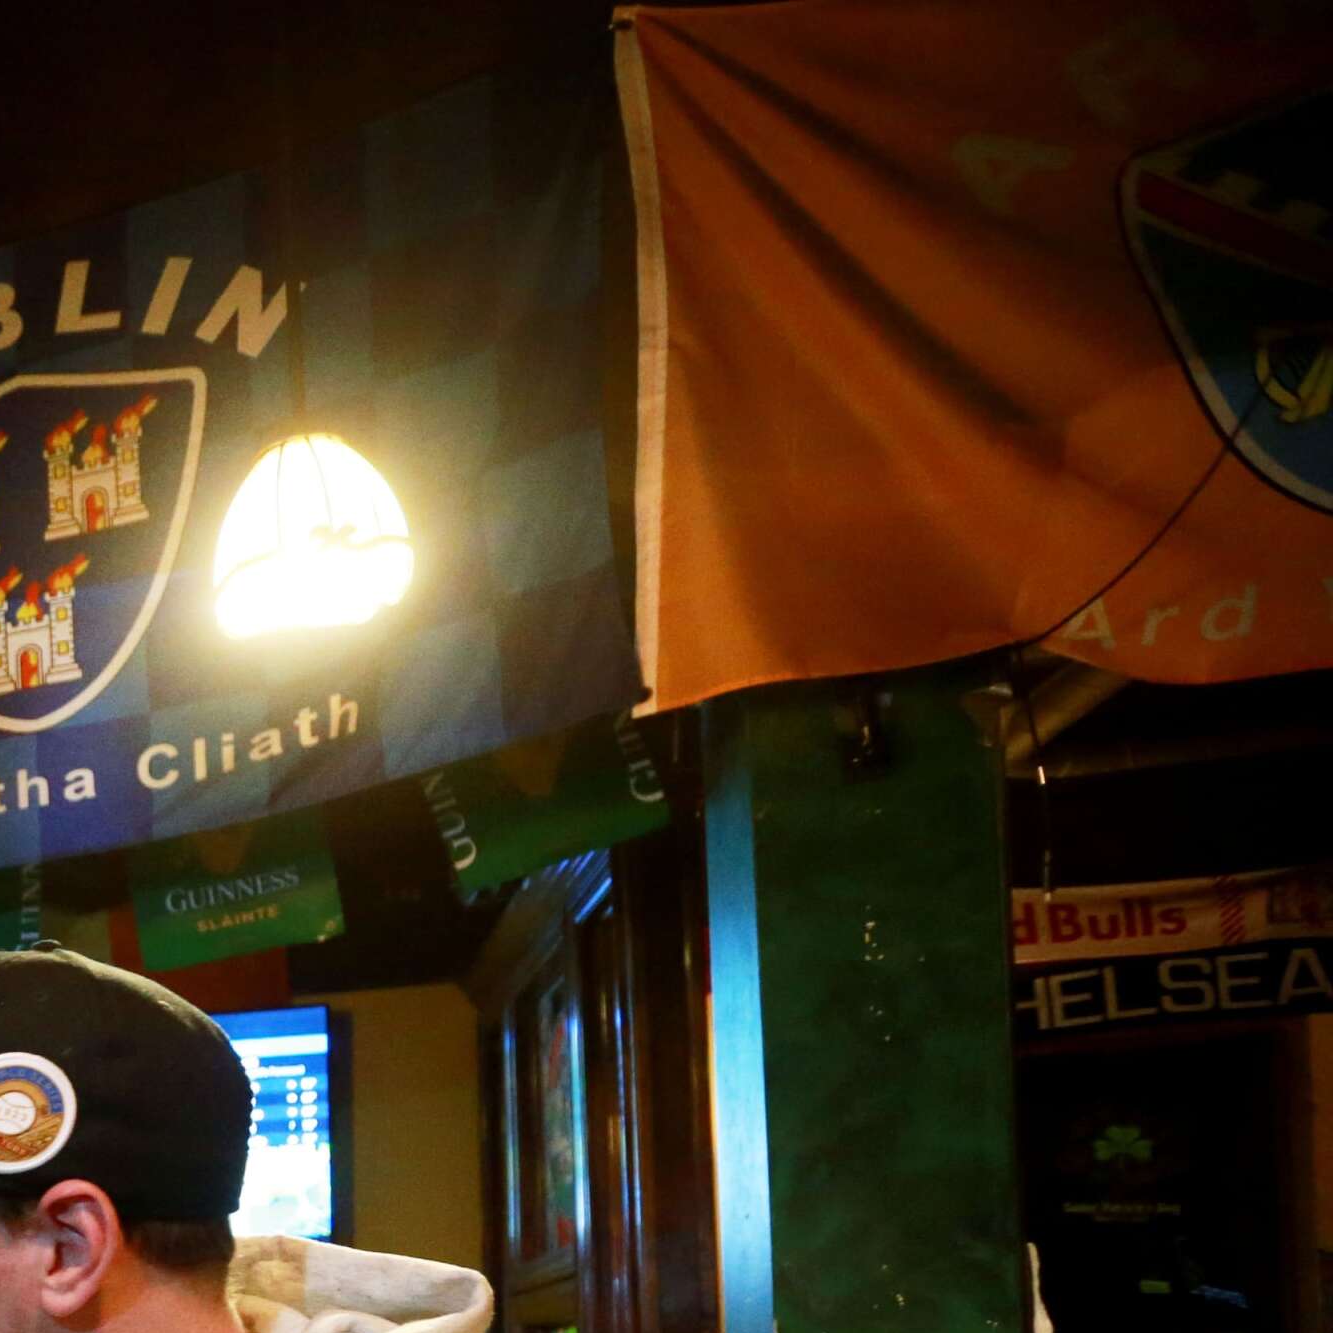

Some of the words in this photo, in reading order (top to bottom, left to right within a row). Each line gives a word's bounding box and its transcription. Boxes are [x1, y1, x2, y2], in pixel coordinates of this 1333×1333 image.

[1059, 580, 1260, 650] Ard
[135, 692, 361, 792] Cliath
[165, 864, 301, 914] GUINNESS
[1046, 897, 1187, 944] Bulls
[1014, 947, 1333, 1031] HELSEA
